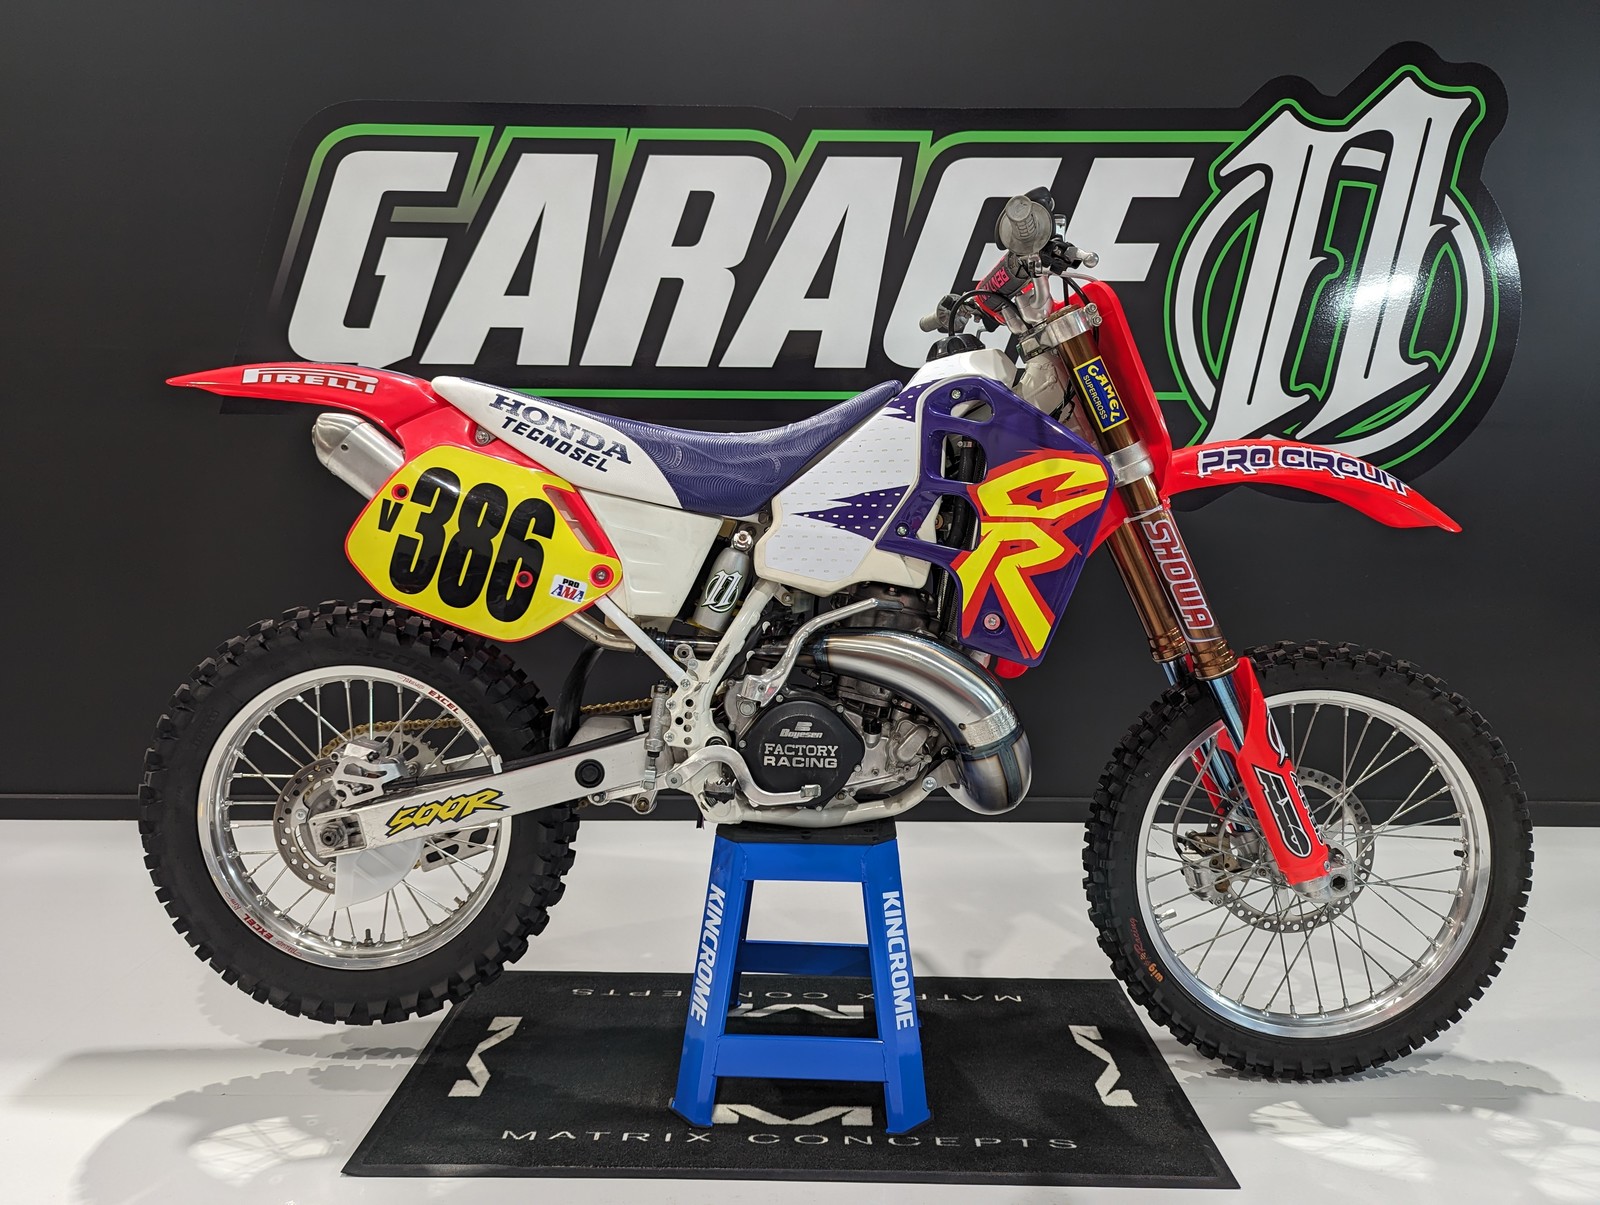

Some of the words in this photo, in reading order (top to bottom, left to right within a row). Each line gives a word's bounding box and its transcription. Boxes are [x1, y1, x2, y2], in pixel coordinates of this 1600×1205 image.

[242, 367, 379, 394] PIRELLI
[1087, 364, 1122, 423] CAMEL
[1082, 375, 1108, 421] SUPERCROSS
[489, 393, 632, 465] HONDA
[502, 416, 608, 473] TECNOSEL
[1199, 446, 1274, 477] PRO
[1279, 446, 1412, 496] CIRCUIT
[388, 467, 556, 623] 386
[562, 578, 580, 589] PRO
[1141, 519, 1215, 630] SHOWA
[550, 584, 585, 603] AMA
[428, 689, 459, 715] EXCEL
[779, 728, 823, 739] Boyesen
[763, 755, 838, 769] RACING
[764, 743, 839, 757] FACTORY
[384, 787, 511, 838] 500R
[243, 913, 274, 940] EXCEL
[690, 883, 726, 1027] KINCROME
[882, 890, 915, 1031] KINCROME
[1148, 963, 1164, 982] wig
[572, 988, 828, 1000] CONEPTS
[857, 993, 1022, 1003] MATX
[501, 1129, 713, 1145] MATRIX
[748, 1133, 1078, 1151] CONCEPTS
